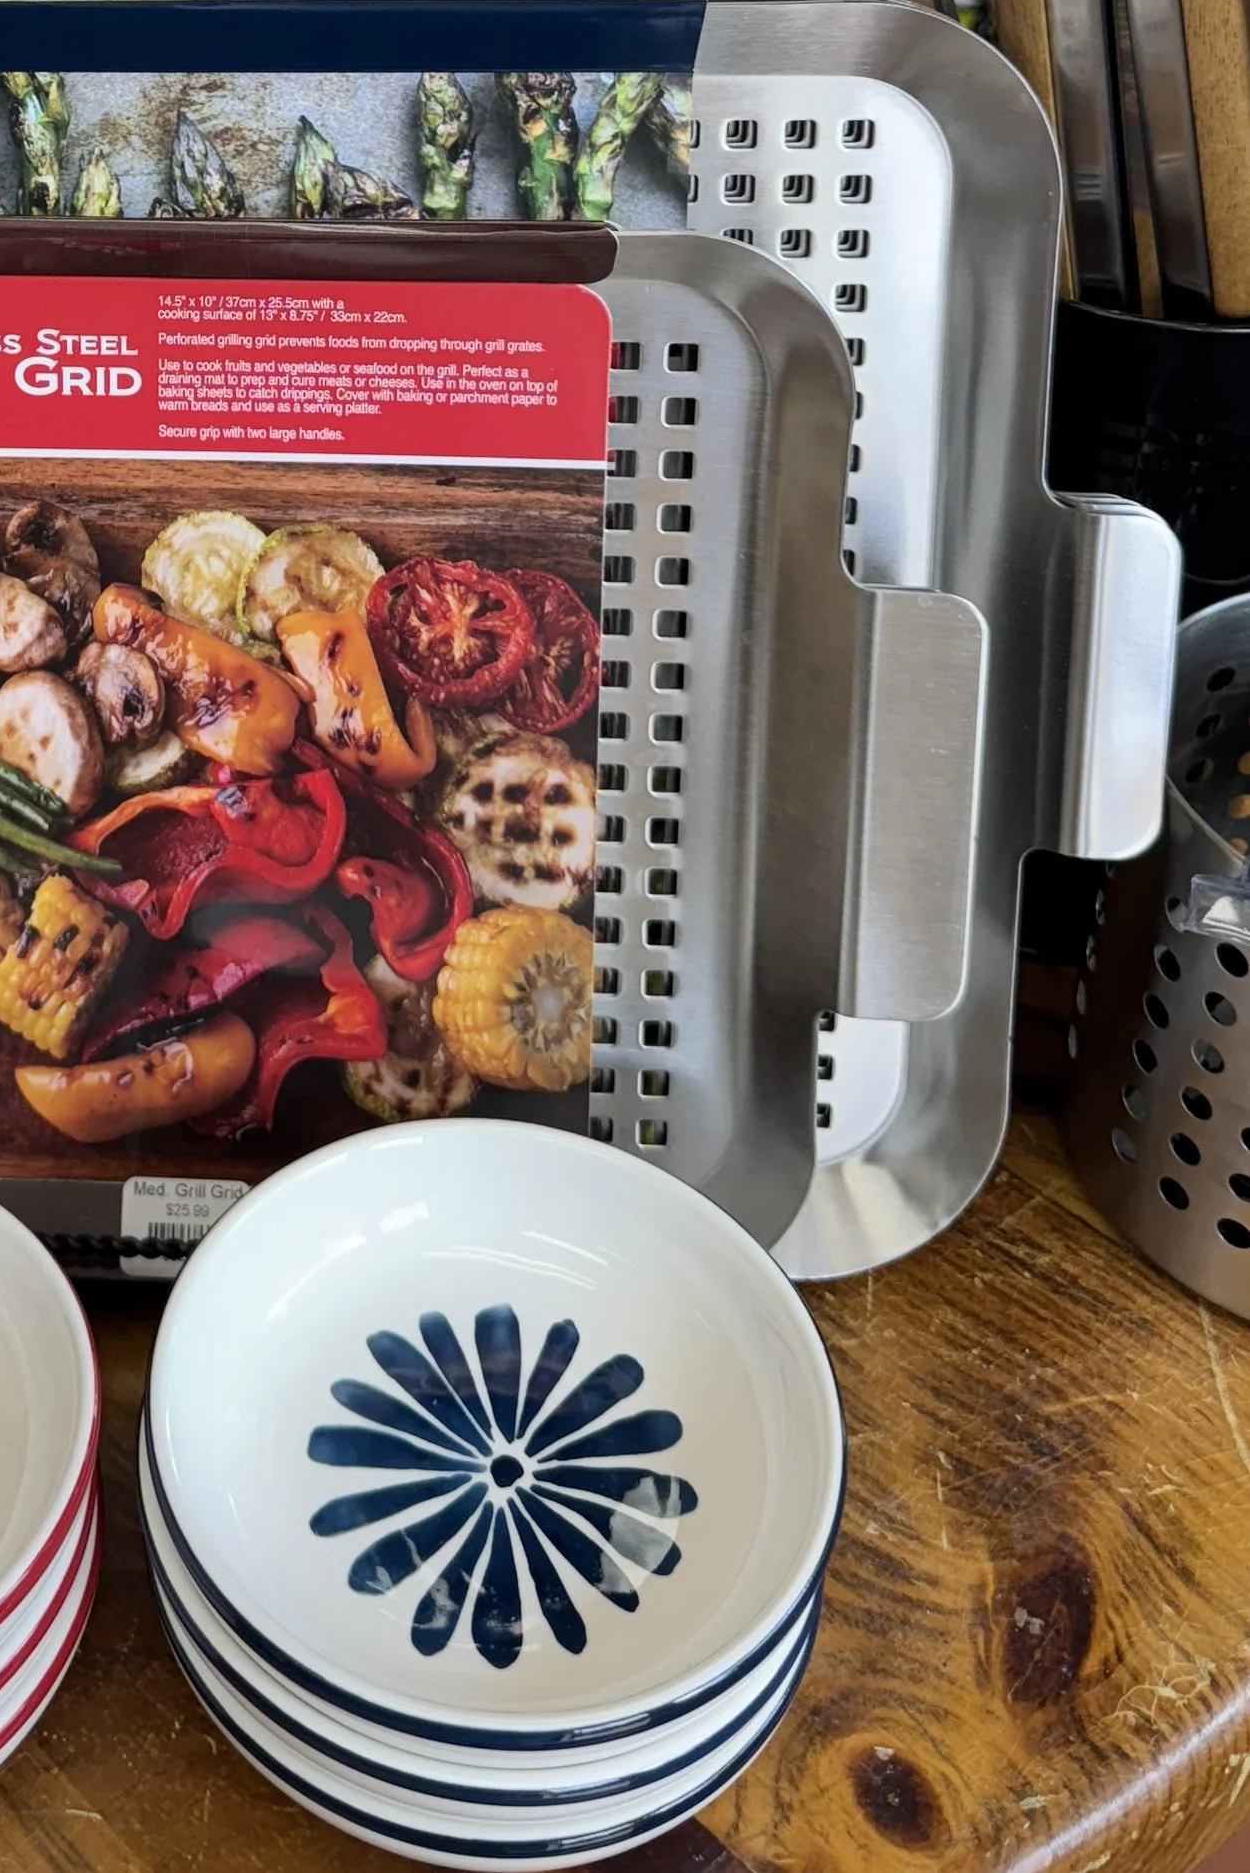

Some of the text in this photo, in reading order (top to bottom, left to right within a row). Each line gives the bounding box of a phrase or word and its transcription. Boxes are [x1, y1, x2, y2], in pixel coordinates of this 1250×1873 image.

[189, 298, 195, 307] x
[226, 297, 256, 308] 37cm
[259, 299, 265, 308] x
[268, 297, 309, 308] 25.5cm
[312, 299, 334, 309] with
[337, 301, 344, 309] a
[158, 333, 545, 354] Perforated grilling grid prevents foods from dropping through grill grates.
[158, 425, 345, 442] Secure grip with two large handles.
[133, 1181, 243, 1199] Med. Grill Grid
